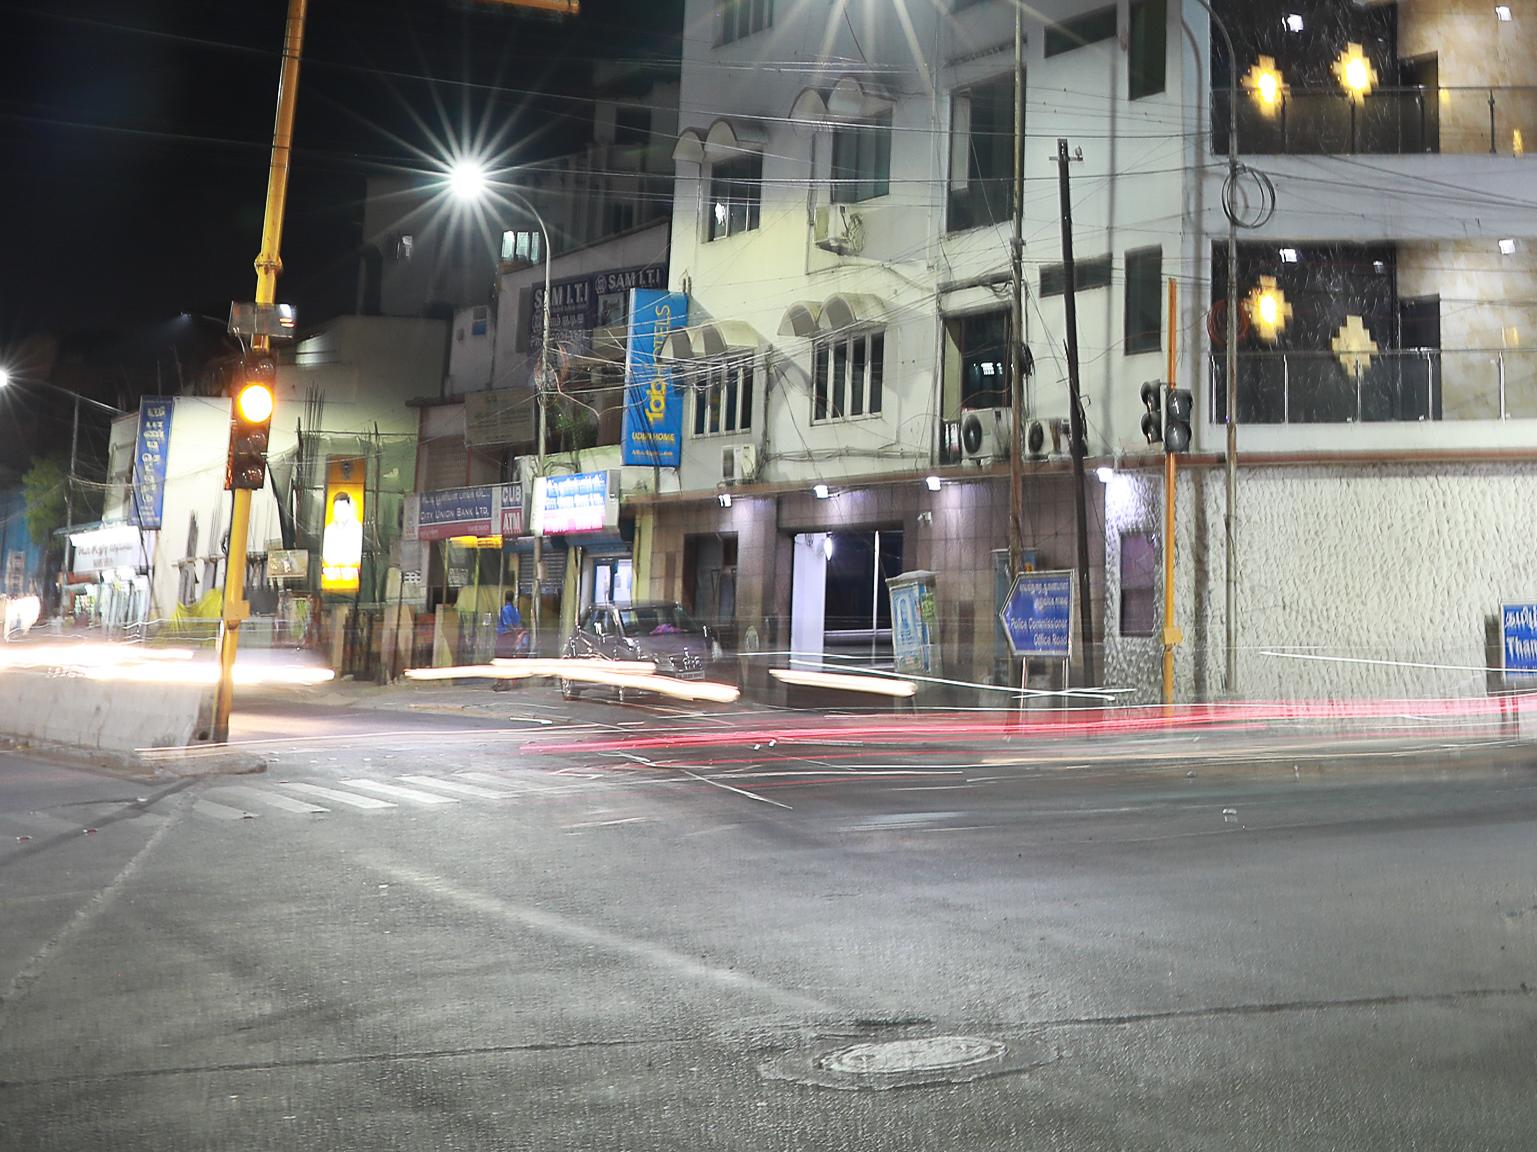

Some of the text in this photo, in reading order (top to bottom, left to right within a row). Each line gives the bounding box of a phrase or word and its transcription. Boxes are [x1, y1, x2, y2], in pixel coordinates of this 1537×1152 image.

[607, 272, 636, 289] SAM
[533, 285, 563, 309] SM
[502, 485, 521, 502] CUB
[456, 507, 474, 517] BANK
[502, 512, 521, 534] ATM
